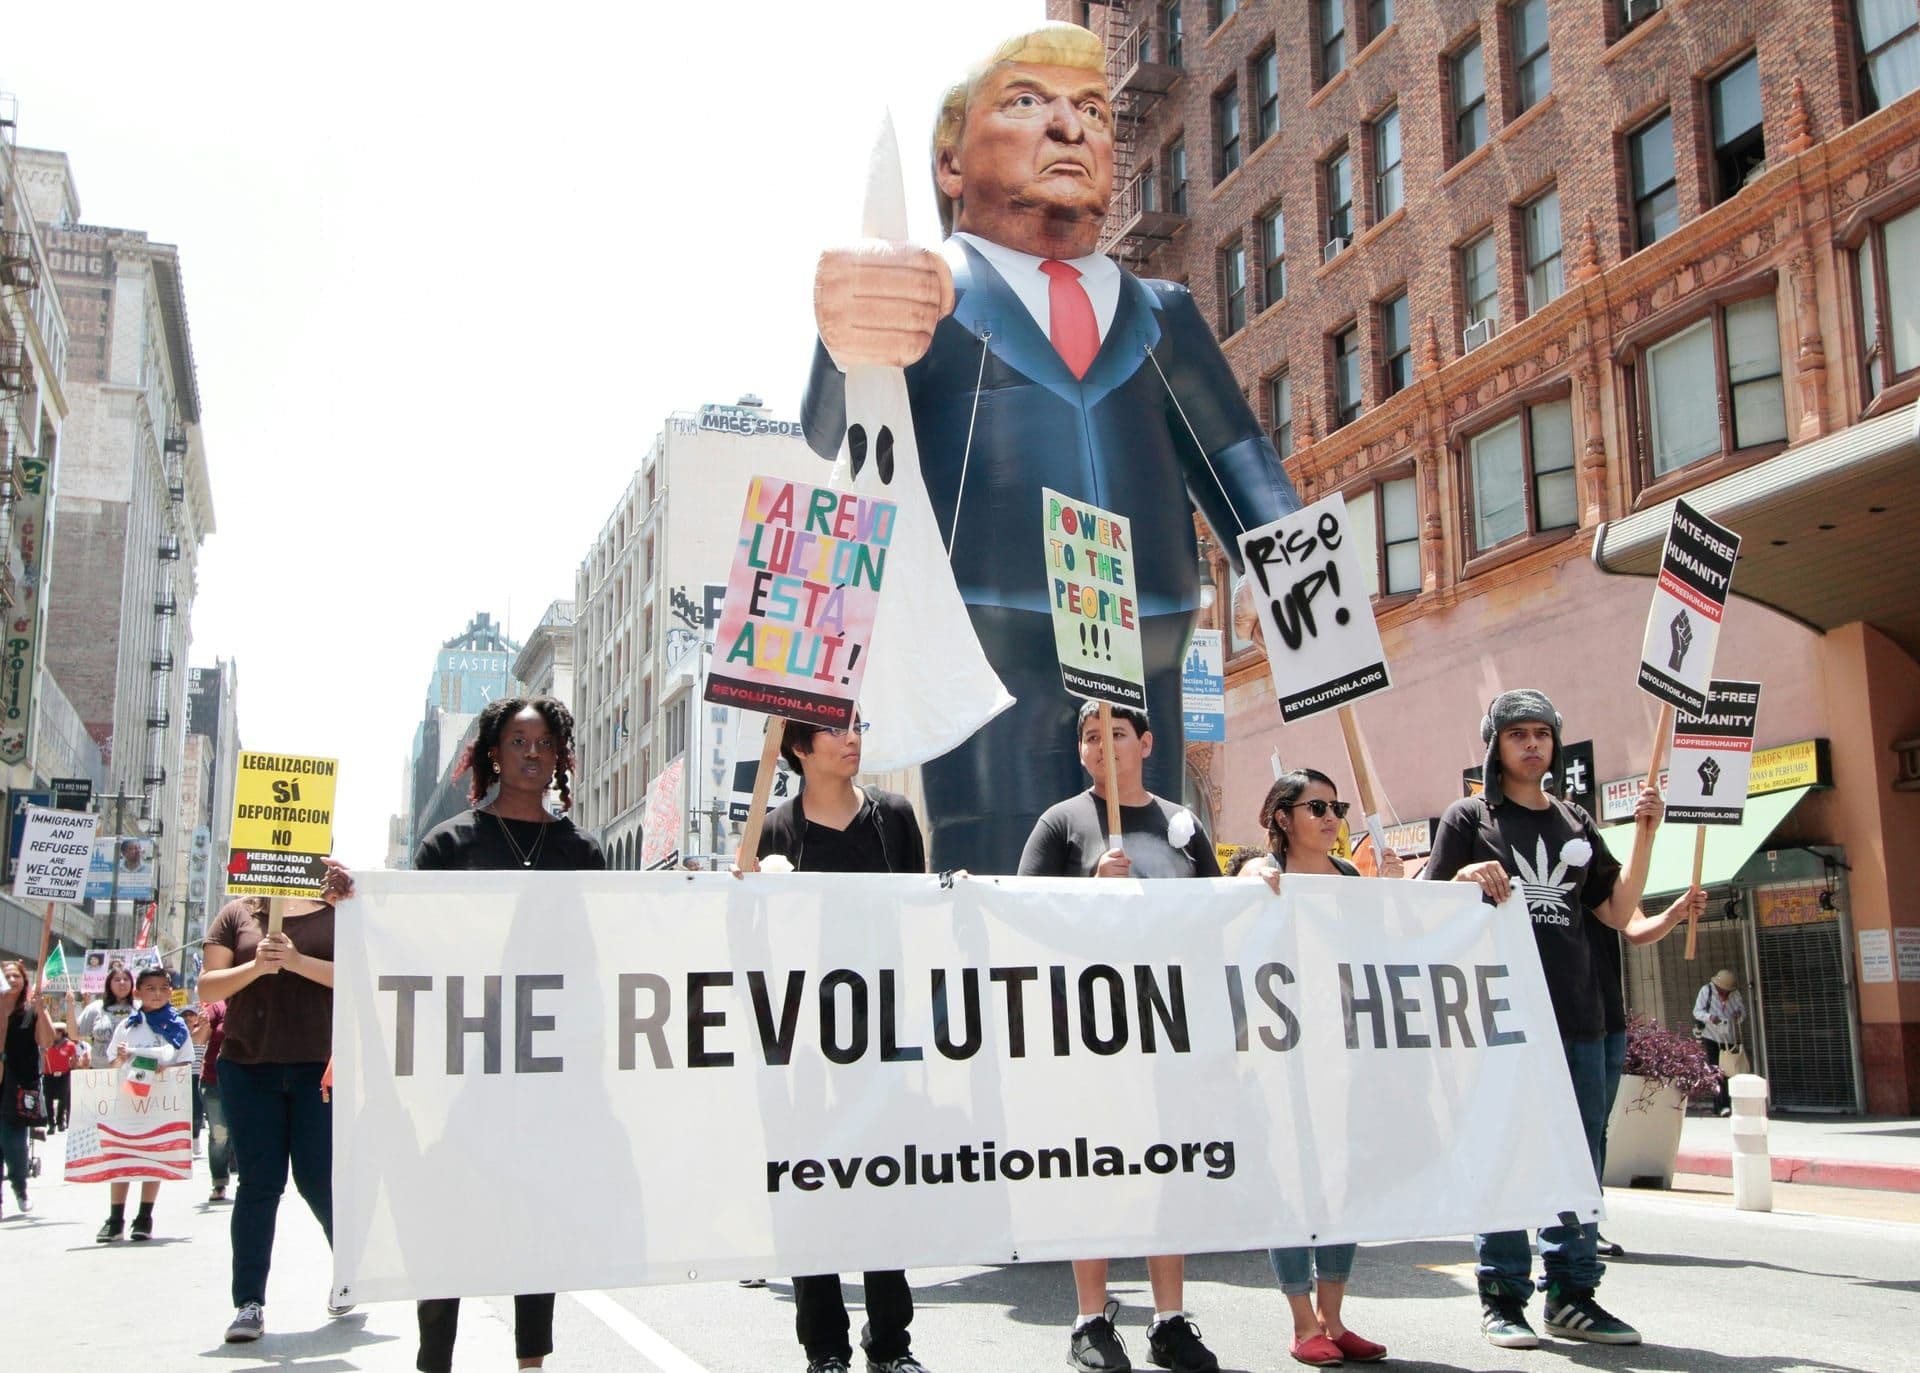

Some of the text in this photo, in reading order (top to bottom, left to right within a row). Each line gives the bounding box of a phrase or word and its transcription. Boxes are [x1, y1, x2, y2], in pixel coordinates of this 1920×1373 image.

[746, 478, 897, 547] LA REVO
[1049, 498, 1127, 552] POWER
[1673, 511, 1735, 562] HATE-FREE
[1049, 539, 1124, 586] TO THE
[1667, 541, 1728, 590] HUMANITY
[749, 570, 846, 634] ESTÁ
[1054, 577, 1135, 631] PEOPLE
[1270, 559, 1351, 651] UP!
[1660, 574, 1721, 617] #OPFREEHUMANITY
[1079, 622, 1112, 662] !!!
[1064, 672, 1141, 700] REVOLUTIONLA.ORG
[1284, 671, 1383, 713] REVOLUTIONLA.ORG
[1640, 668, 1702, 710] REVOLUTIONLA.ORG
[712, 683, 846, 718] REVOLUTIONLA.ORG
[1675, 739, 1748, 748] #OPFREEHUMANITY
[243, 754, 335, 776] LEGALIZACION
[31, 814, 94, 828] IMMIGRANTS
[238, 804, 330, 825] DEPORTACION
[1668, 810, 1740, 819] REVOLUTIONLA.ORG
[30, 841, 89, 856] REFUGEES
[50, 829, 75, 840] AND
[271, 829, 292, 847] NO
[26, 863, 84, 878] WELCOME
[49, 857, 66, 865] ARE
[246, 852, 313, 864] HERMANDAD
[250, 863, 306, 875] MEXICANA
[28, 876, 80, 887] NOT TRUMP!
[28, 887, 76, 898] PSLWEB.ORG
[233, 873, 321, 886] TRANSNACIONAL
[378, 962, 1527, 1076] THE REVOLUTION IS HERE
[766, 1136, 1237, 1194] revolutionla.org
